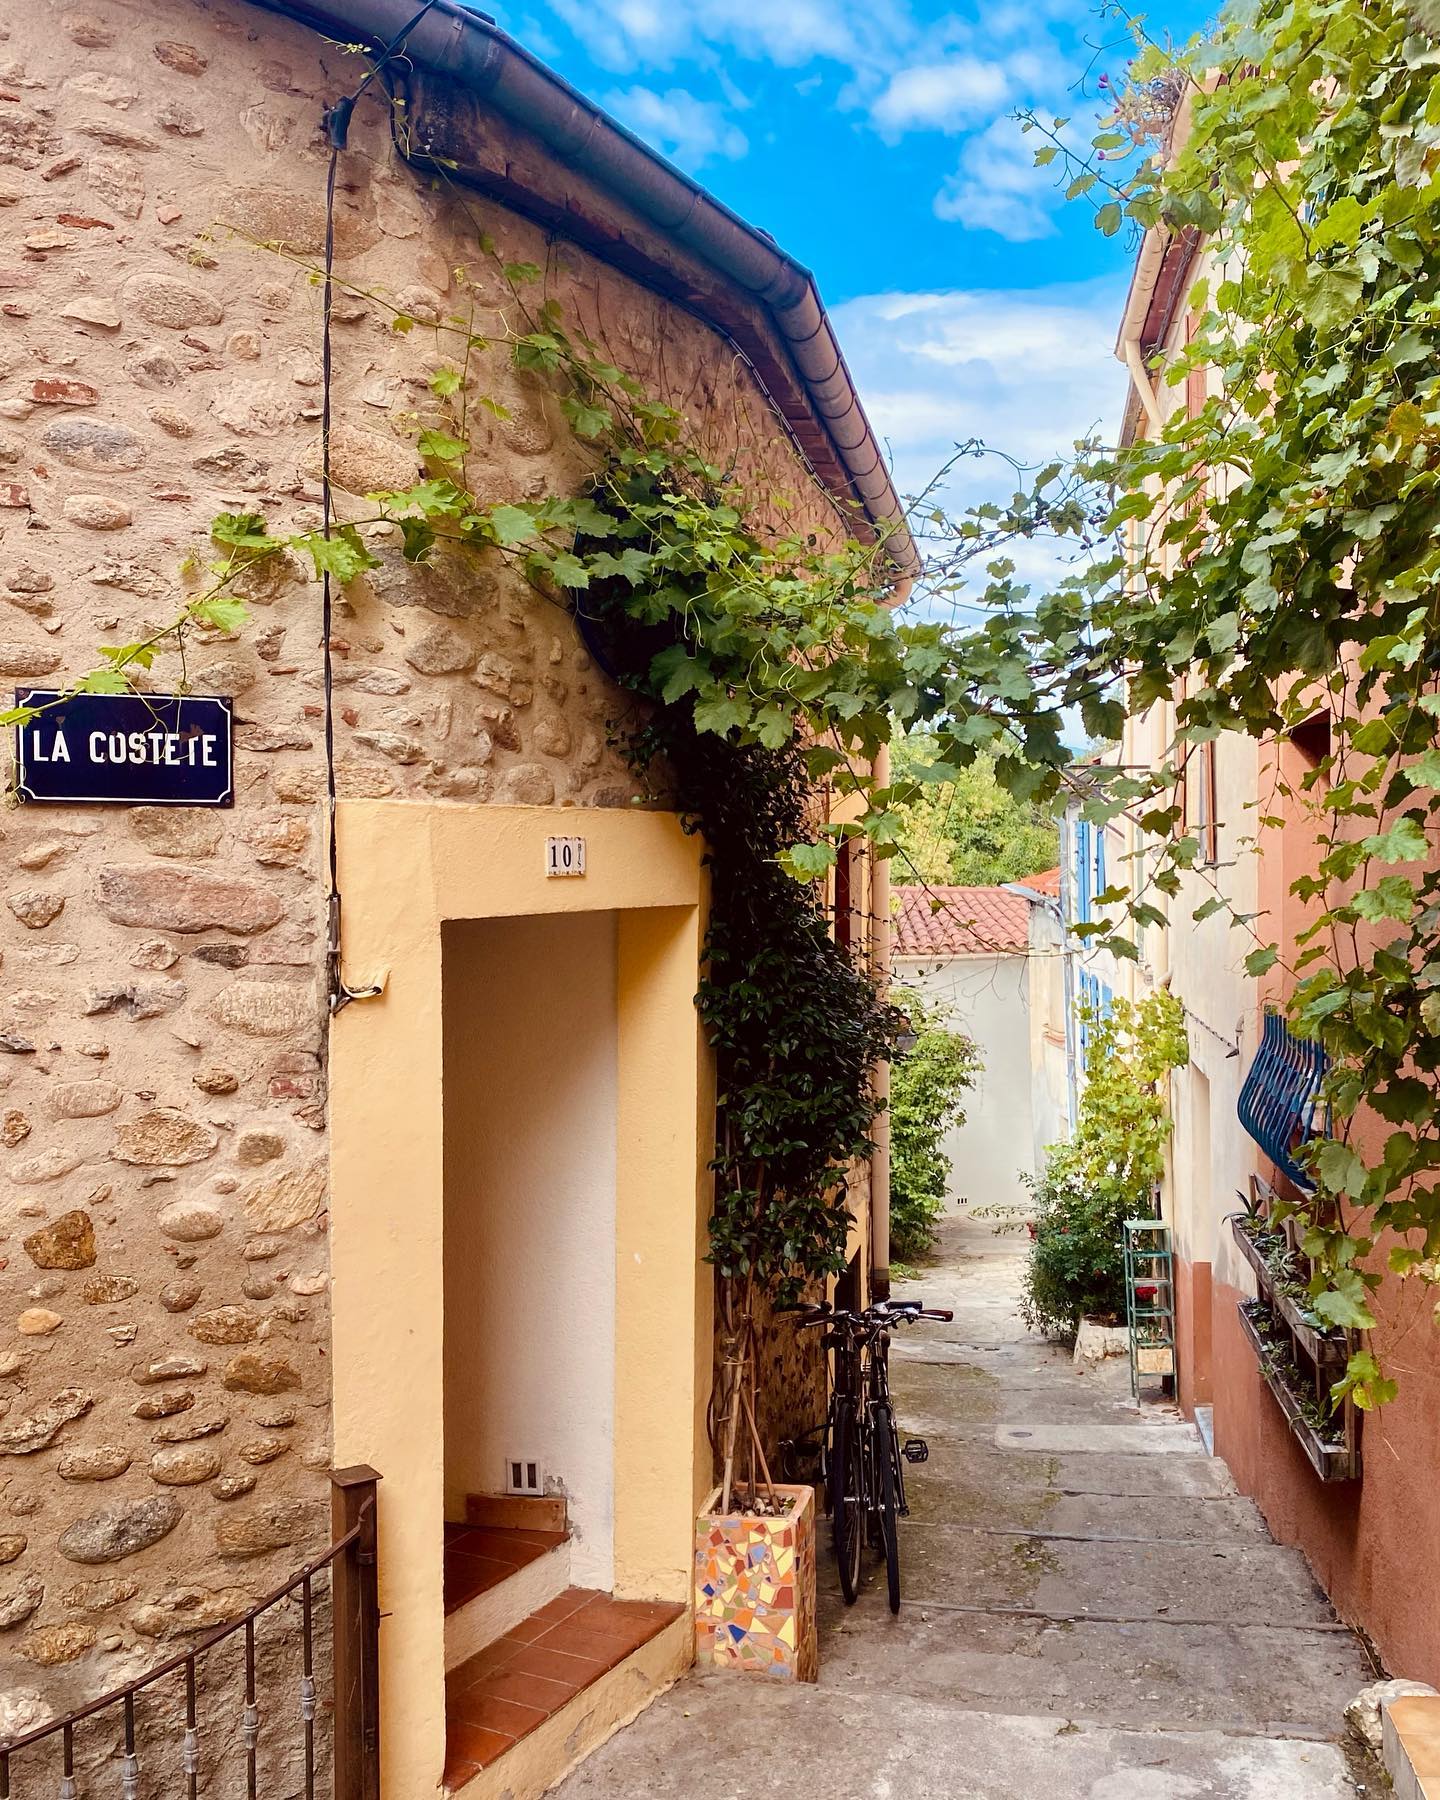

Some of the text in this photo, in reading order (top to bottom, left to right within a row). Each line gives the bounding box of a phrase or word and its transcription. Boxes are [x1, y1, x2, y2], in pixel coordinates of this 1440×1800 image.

[33, 730, 217, 767] LA COSTETE
[551, 844, 572, 868] 10
